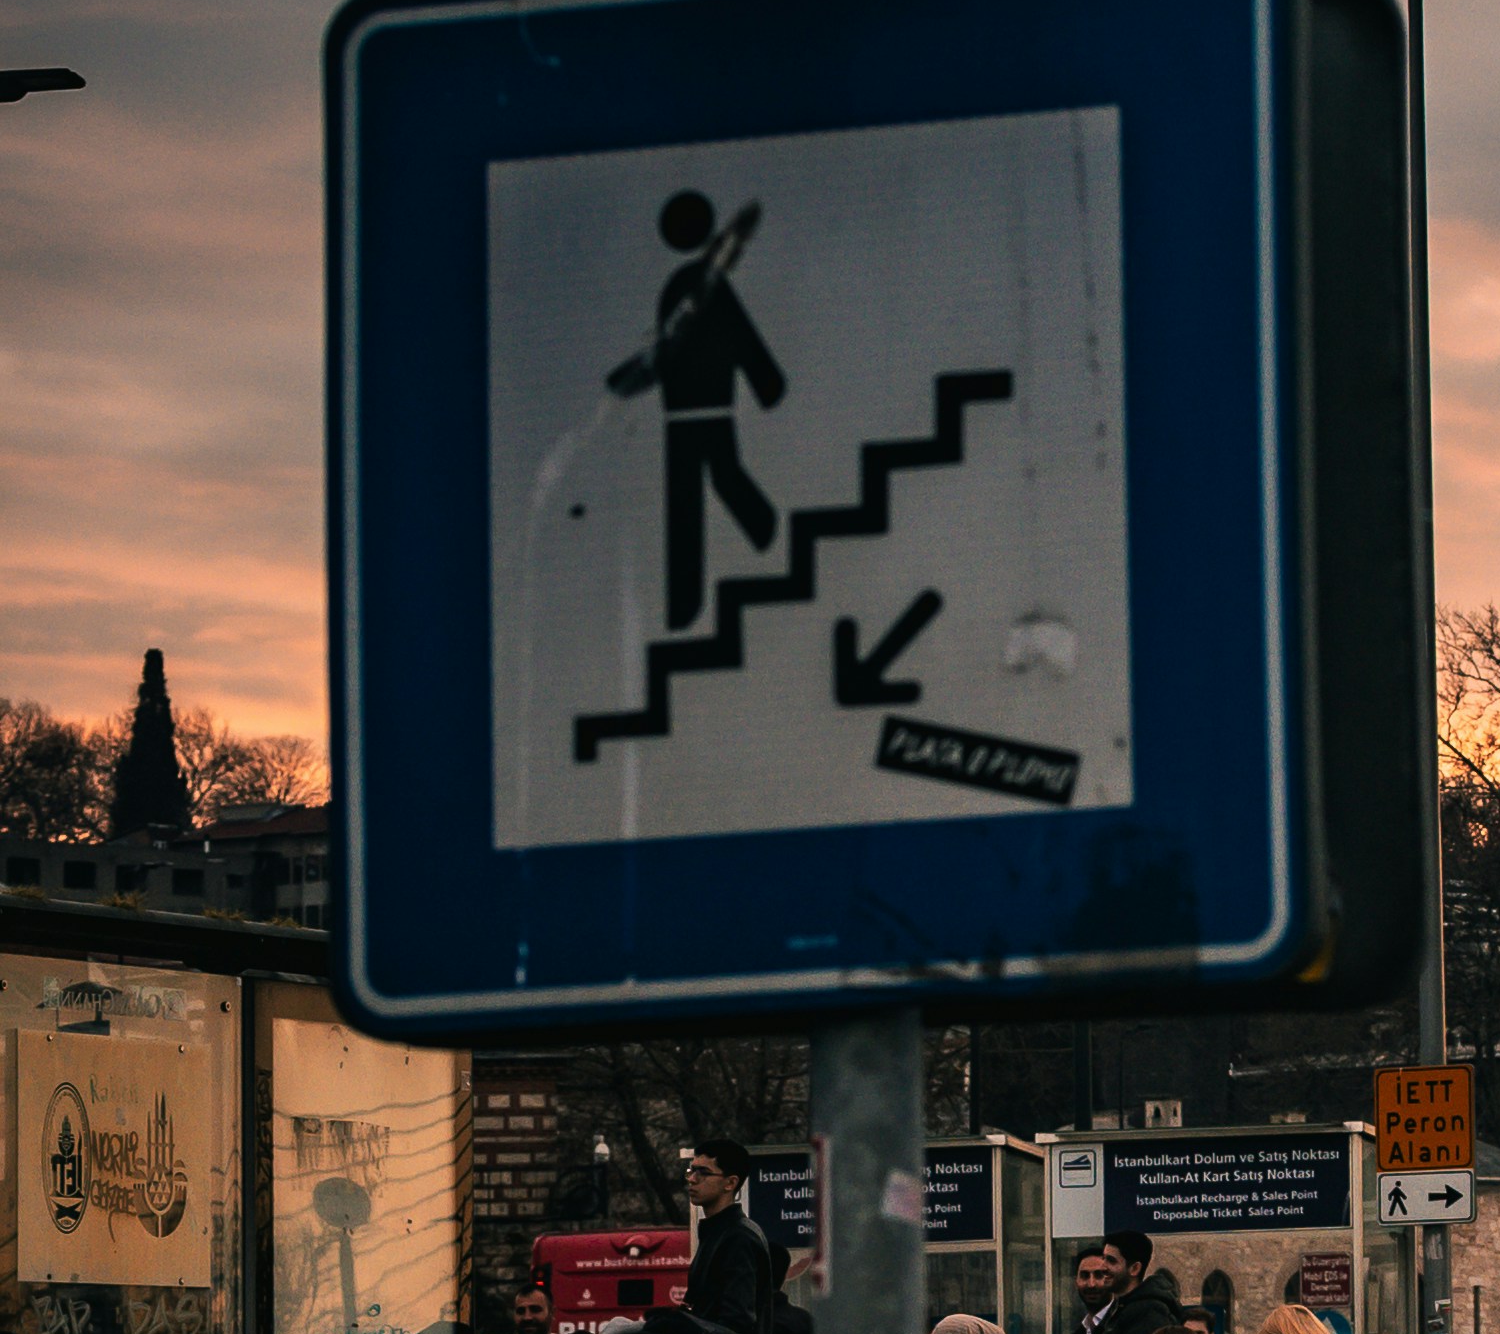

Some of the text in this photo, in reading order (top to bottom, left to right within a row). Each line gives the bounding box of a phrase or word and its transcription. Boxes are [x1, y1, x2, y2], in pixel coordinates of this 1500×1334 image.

[1396, 1076, 1453, 1105] İETT
[1386, 1112, 1464, 1134] Peron
[1114, 1148, 1340, 1168] İstanbulkart Dolum ve Satış Noktası
[1389, 1141, 1460, 1164] Alanı
[935, 1162, 983, 1175] Noktası
[1139, 1168, 1315, 1185] Kullan-At Kart Satış Noktası
[784, 1182, 959, 1200] Kulla oktası
[1136, 1190, 1318, 1206] İstanbulkart Recharge & Sales Point
[935, 1203, 962, 1213] Point
[1153, 1205, 1304, 1221] Disposable Ticket Sales Point
[921, 1219, 947, 1229] Point
[575, 1255, 689, 1269] www.busforus.istanbu
